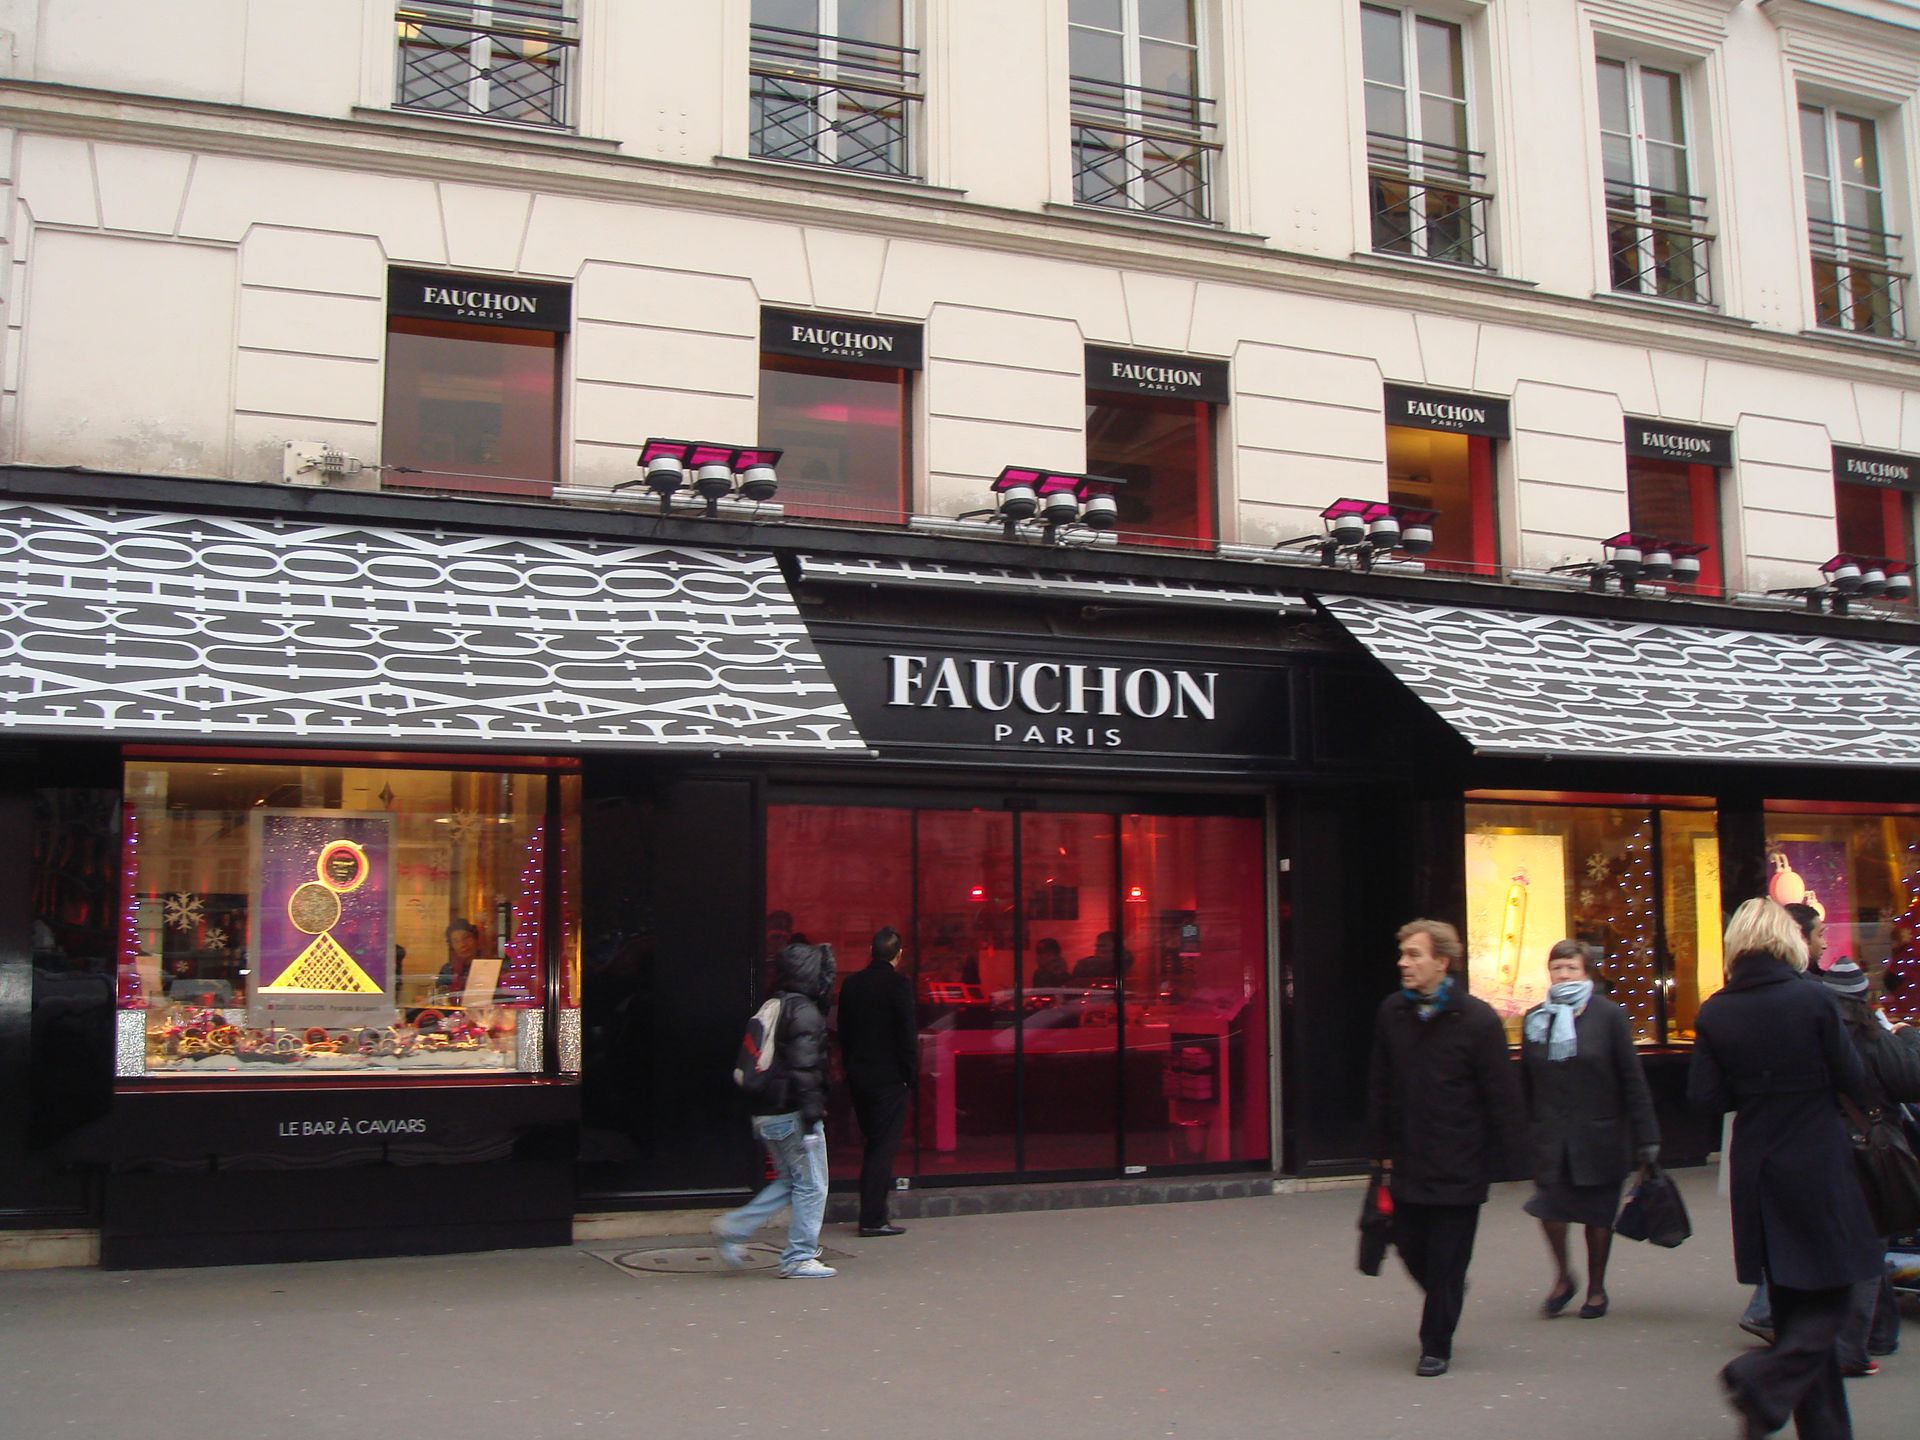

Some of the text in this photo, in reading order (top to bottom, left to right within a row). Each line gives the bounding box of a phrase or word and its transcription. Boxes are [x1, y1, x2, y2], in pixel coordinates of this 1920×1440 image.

[423, 286, 538, 313] FAUCHON
[457, 308, 504, 319] PARIS
[791, 325, 894, 352] FAUCHON
[821, 347, 864, 357] PARIS
[1111, 362, 1202, 387] FAUCHON
[1138, 382, 1177, 392] PARIS
[1406, 400, 1485, 423] FAUCHON
[1430, 419, 1464, 429] PARIS
[1641, 432, 1711, 453] FAUCHON
[1847, 459, 1909, 480] FAUCHON
[888, 654, 1219, 720] FAUCHON
[995, 724, 1122, 747] PARIS
[279, 1117, 427, 1136] LE BAR À CAVIARS
